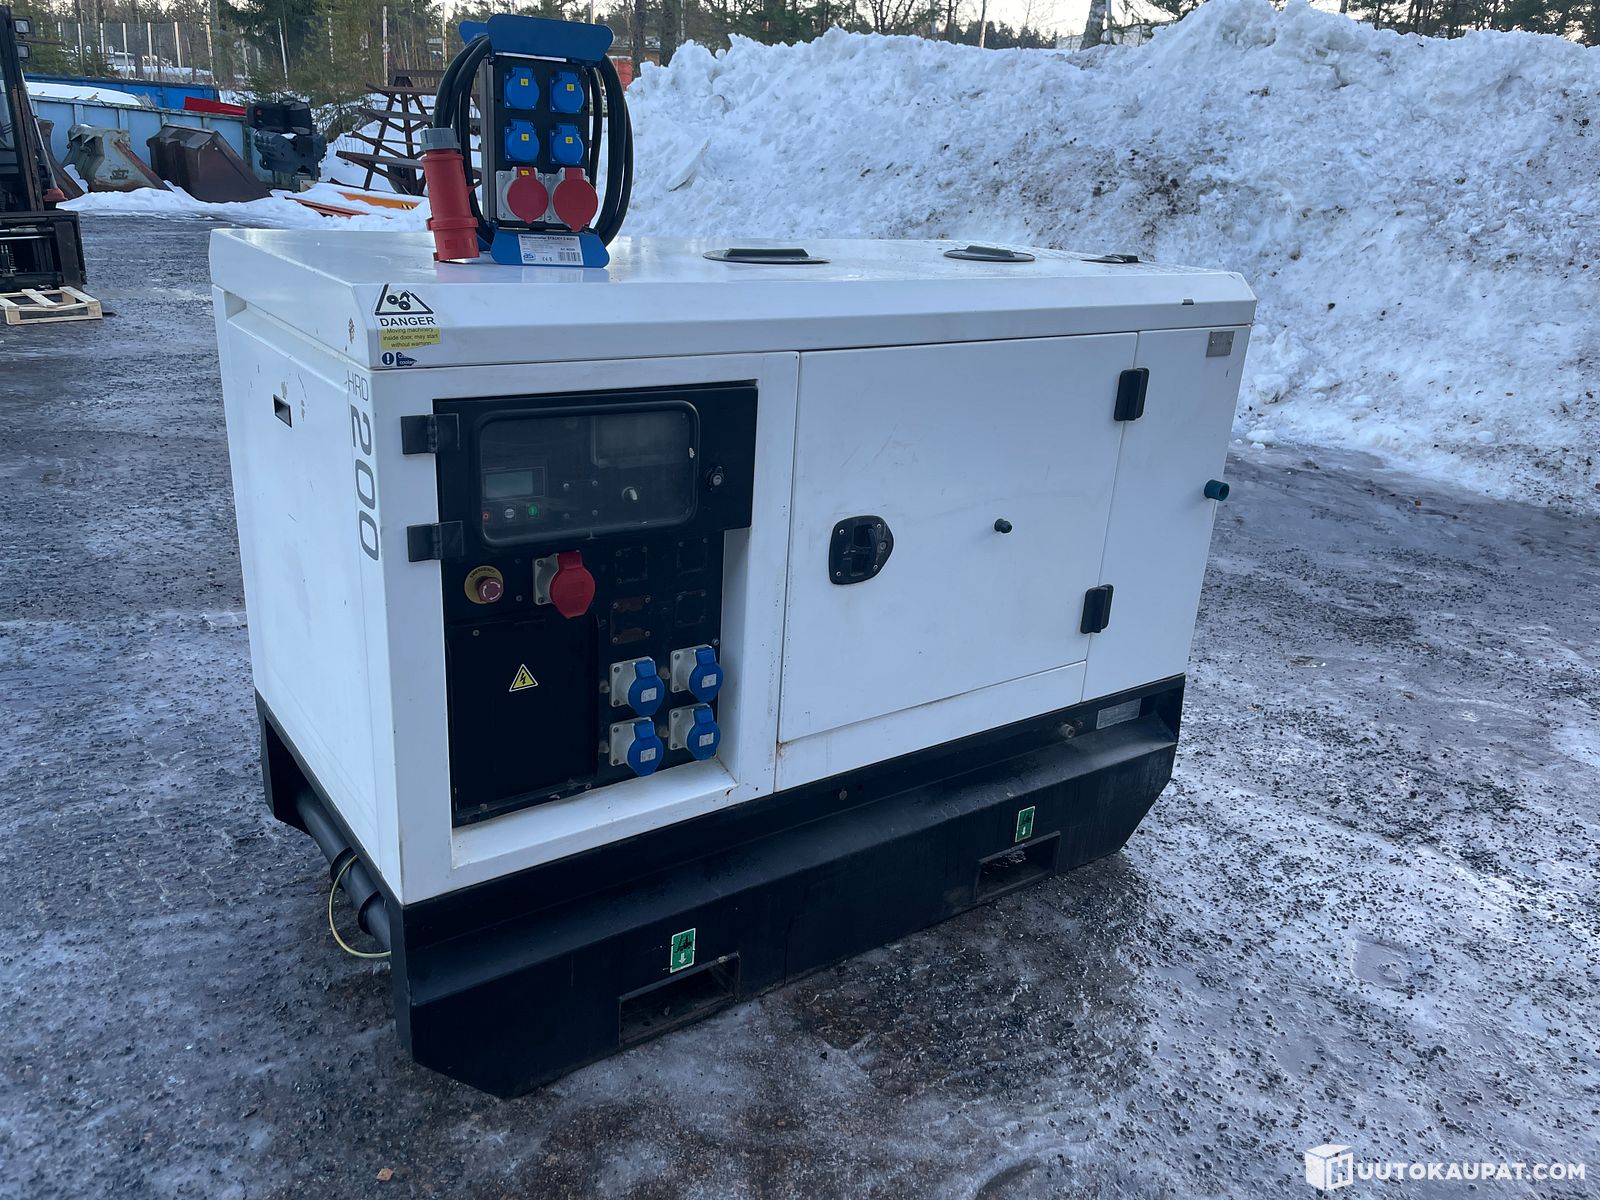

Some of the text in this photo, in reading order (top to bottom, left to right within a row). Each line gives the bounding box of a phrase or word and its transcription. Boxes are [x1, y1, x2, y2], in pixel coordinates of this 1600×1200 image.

[379, 317, 436, 327] DANGER
[347, 370, 369, 402] HRD
[350, 404, 380, 561] 200
